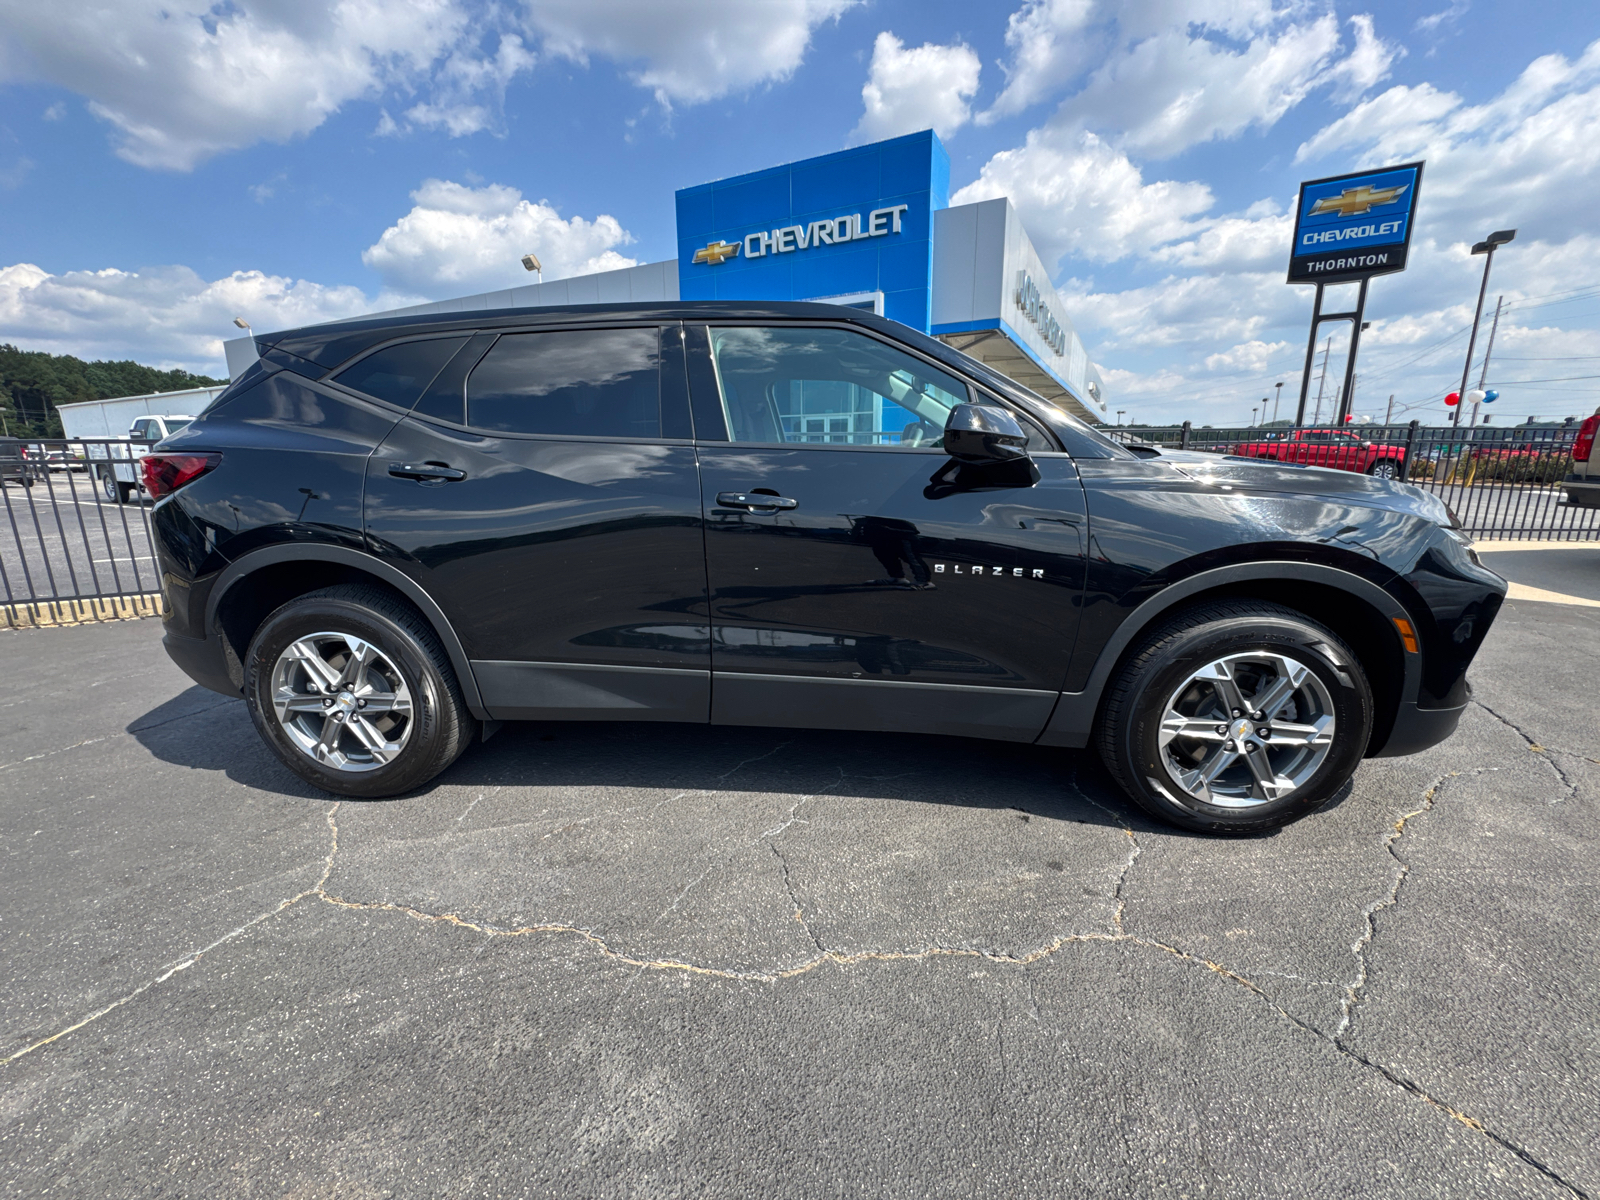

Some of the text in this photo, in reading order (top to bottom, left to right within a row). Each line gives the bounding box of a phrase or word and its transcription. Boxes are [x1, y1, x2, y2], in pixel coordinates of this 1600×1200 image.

[744, 204, 908, 259] CHEVROLET
[1303, 221, 1402, 245] CHEVROLET
[1307, 254, 1388, 272] THORNTON
[934, 563, 1044, 579] BLAZER
